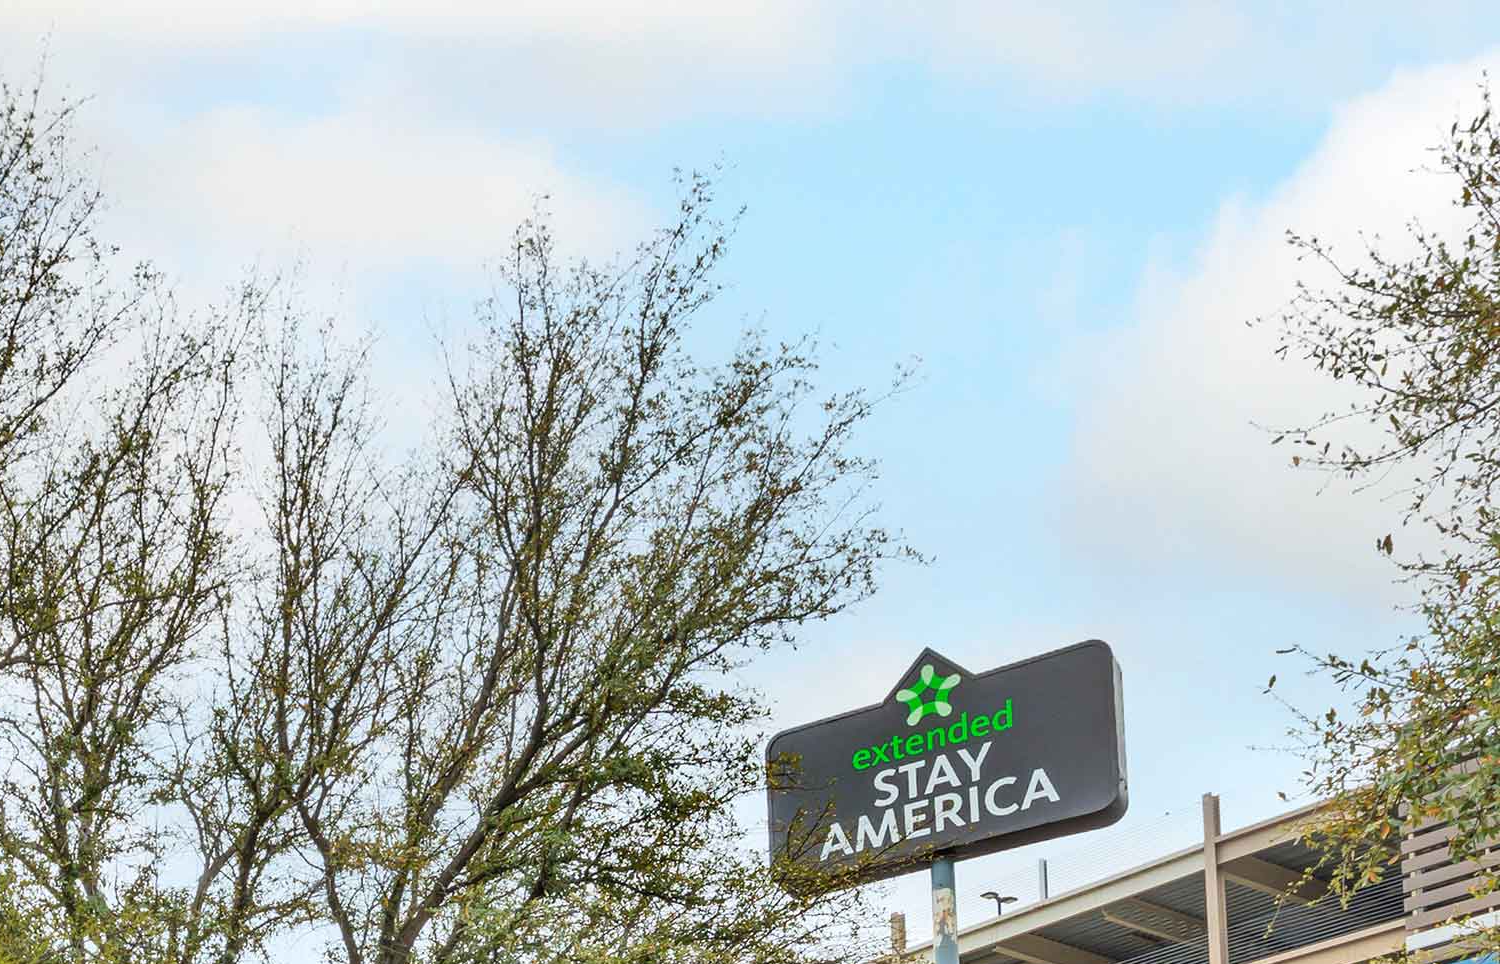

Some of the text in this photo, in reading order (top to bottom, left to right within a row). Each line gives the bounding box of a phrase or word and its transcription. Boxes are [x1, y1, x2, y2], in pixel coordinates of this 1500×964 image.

[851, 698, 1014, 771] extended
[873, 741, 992, 808] STAY
[819, 768, 1061, 861] AMERICA
